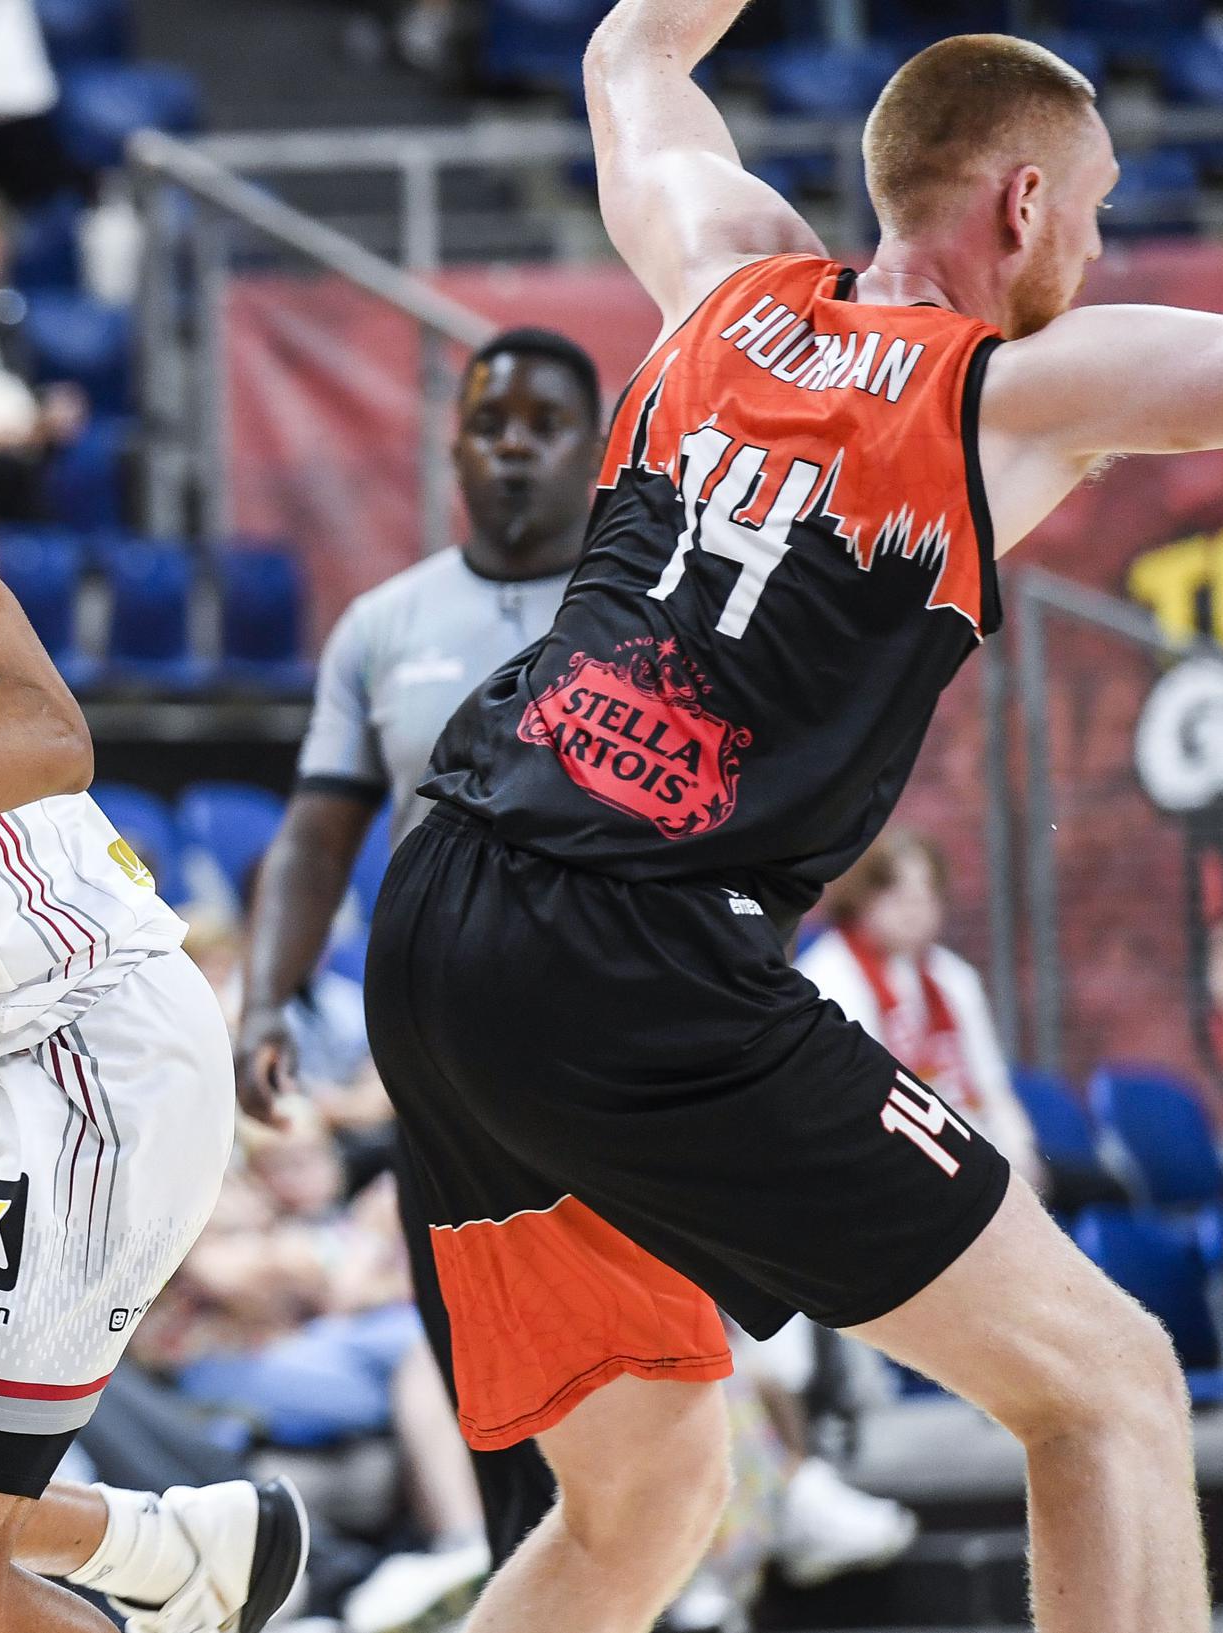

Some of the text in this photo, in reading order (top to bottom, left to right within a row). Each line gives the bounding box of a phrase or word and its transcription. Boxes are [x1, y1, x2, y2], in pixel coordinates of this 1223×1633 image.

[646, 426, 823, 640] 14
[549, 721, 690, 806] ARTOIS
[562, 687, 703, 777] STELLA
[879, 1068, 971, 1179] 14
